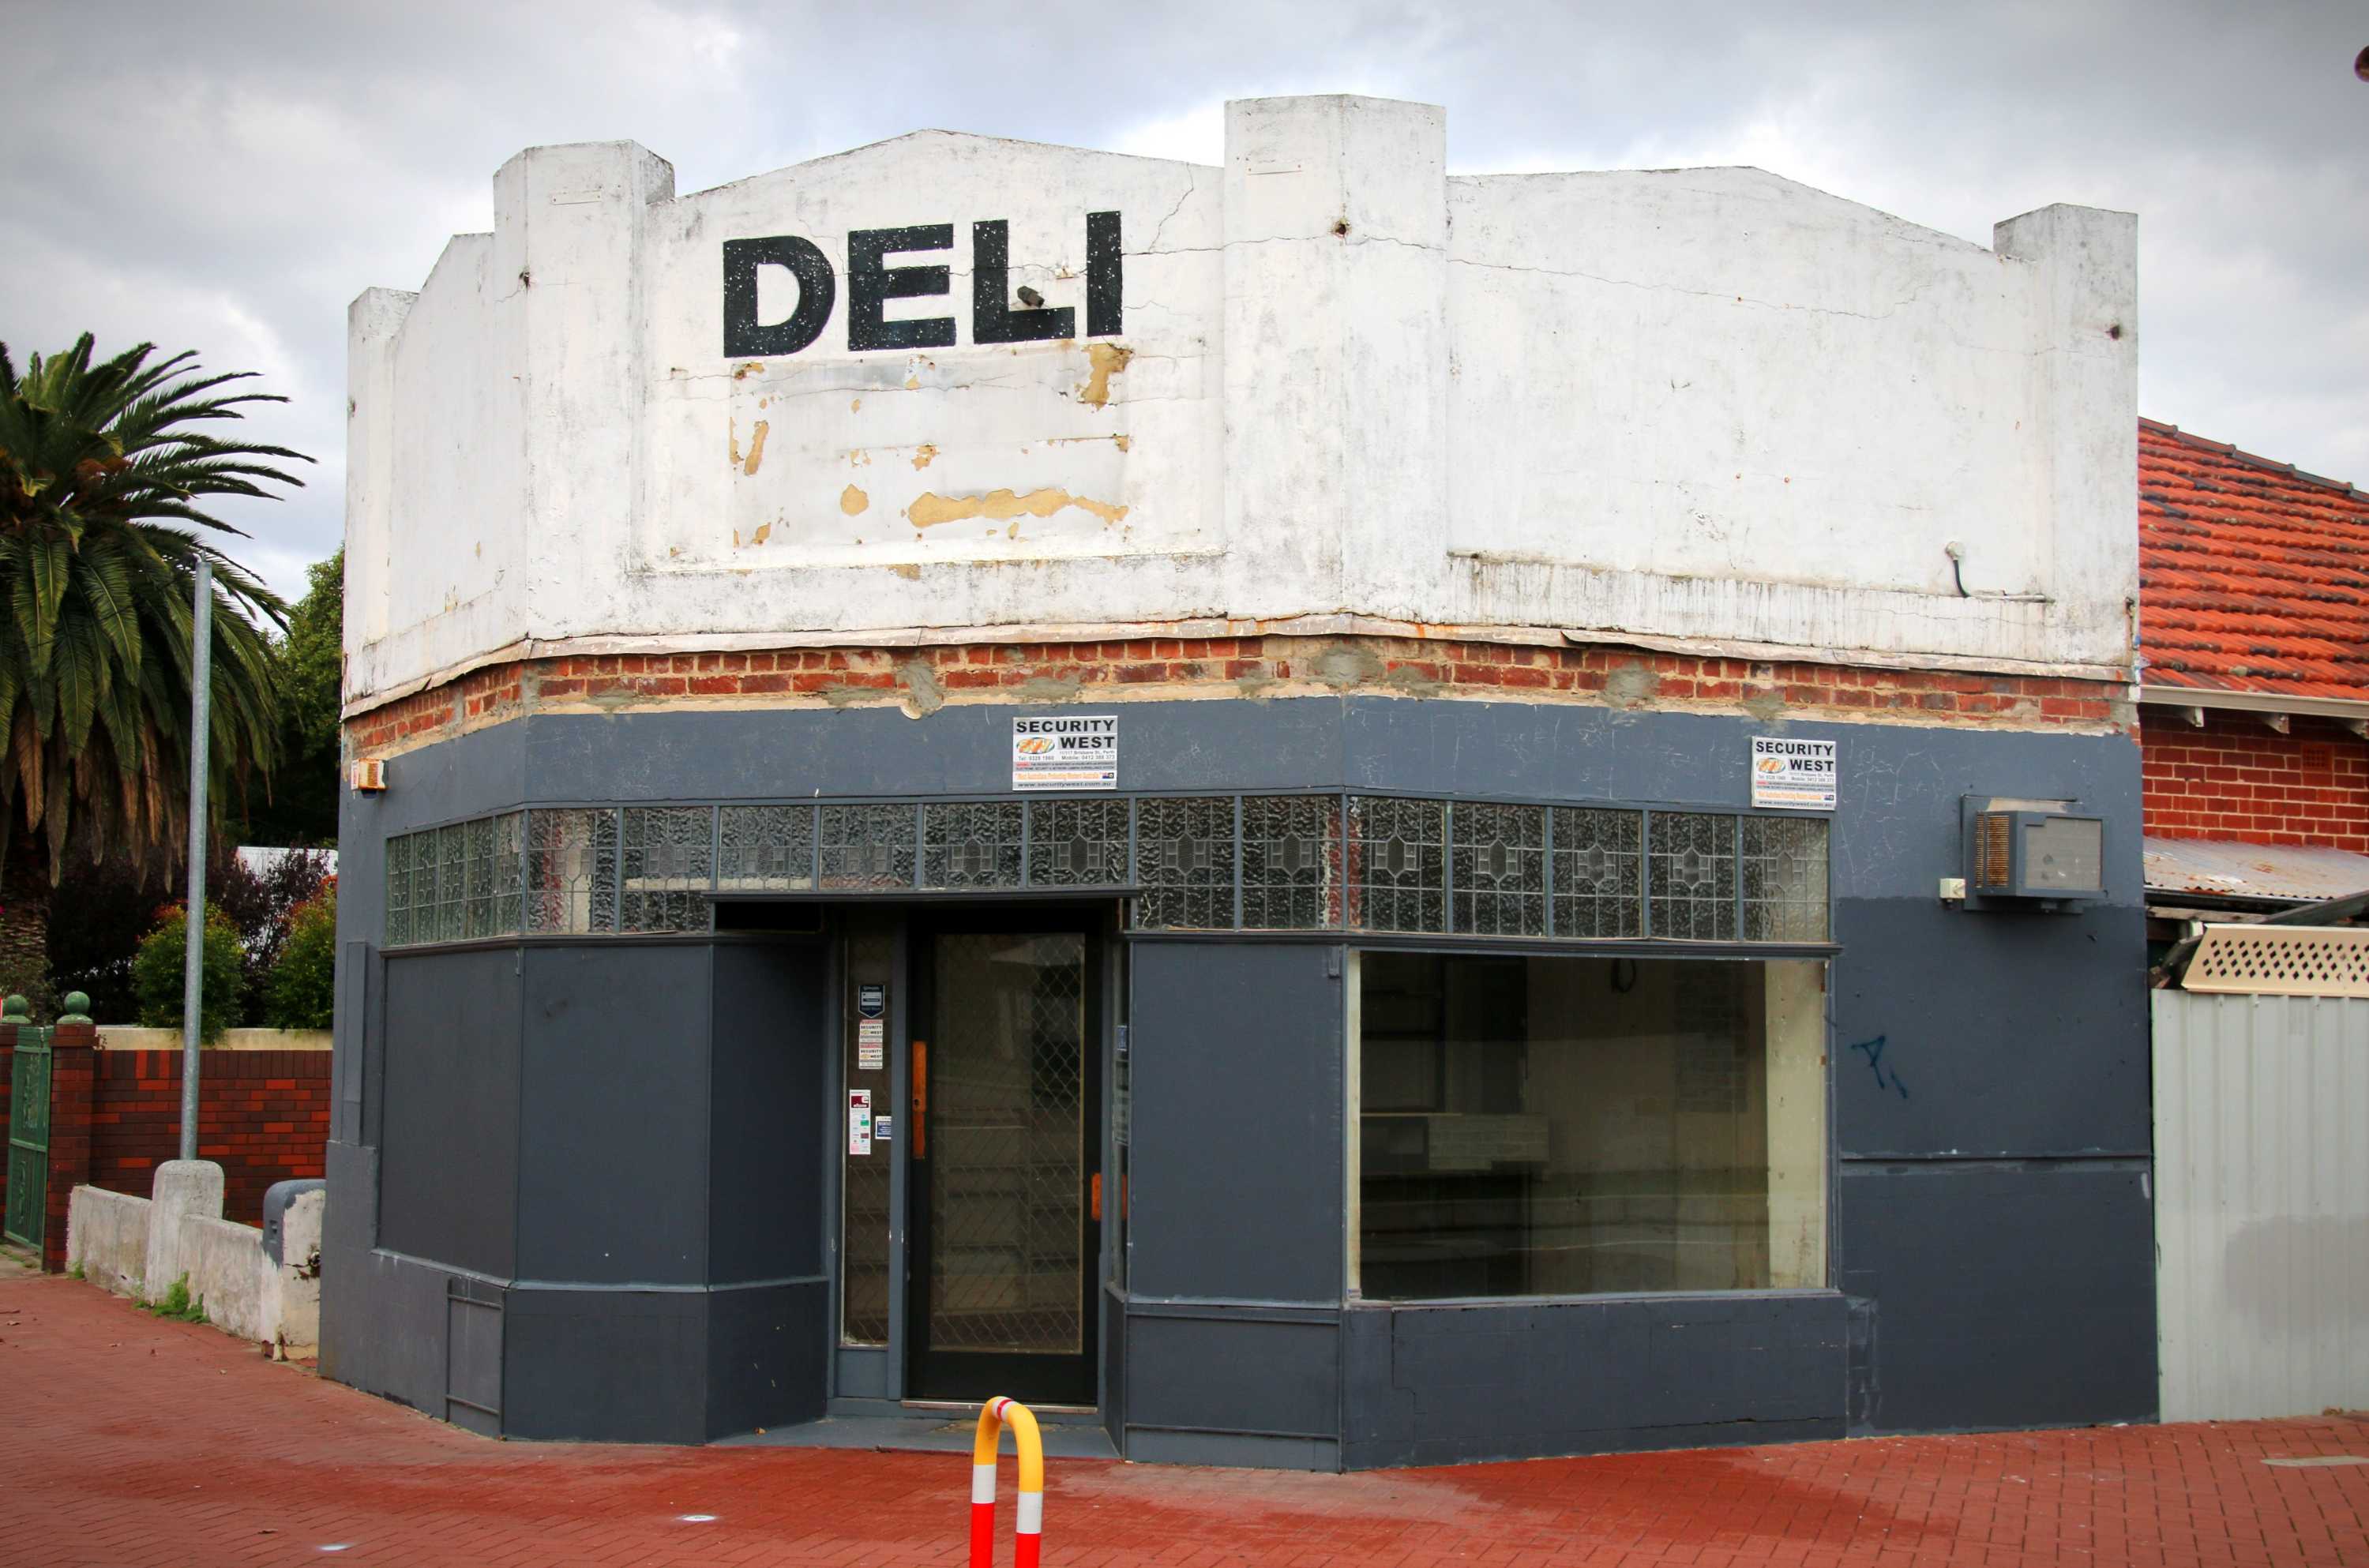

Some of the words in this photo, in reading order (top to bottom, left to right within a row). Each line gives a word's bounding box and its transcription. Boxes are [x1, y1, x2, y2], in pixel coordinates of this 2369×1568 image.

[723, 211, 1123, 358] DELI
[1016, 719, 1115, 733] SECURITY
[1060, 736, 1115, 748] WEST
[1755, 741, 1834, 756] SECURITY
[1789, 759, 1834, 771] WEST
